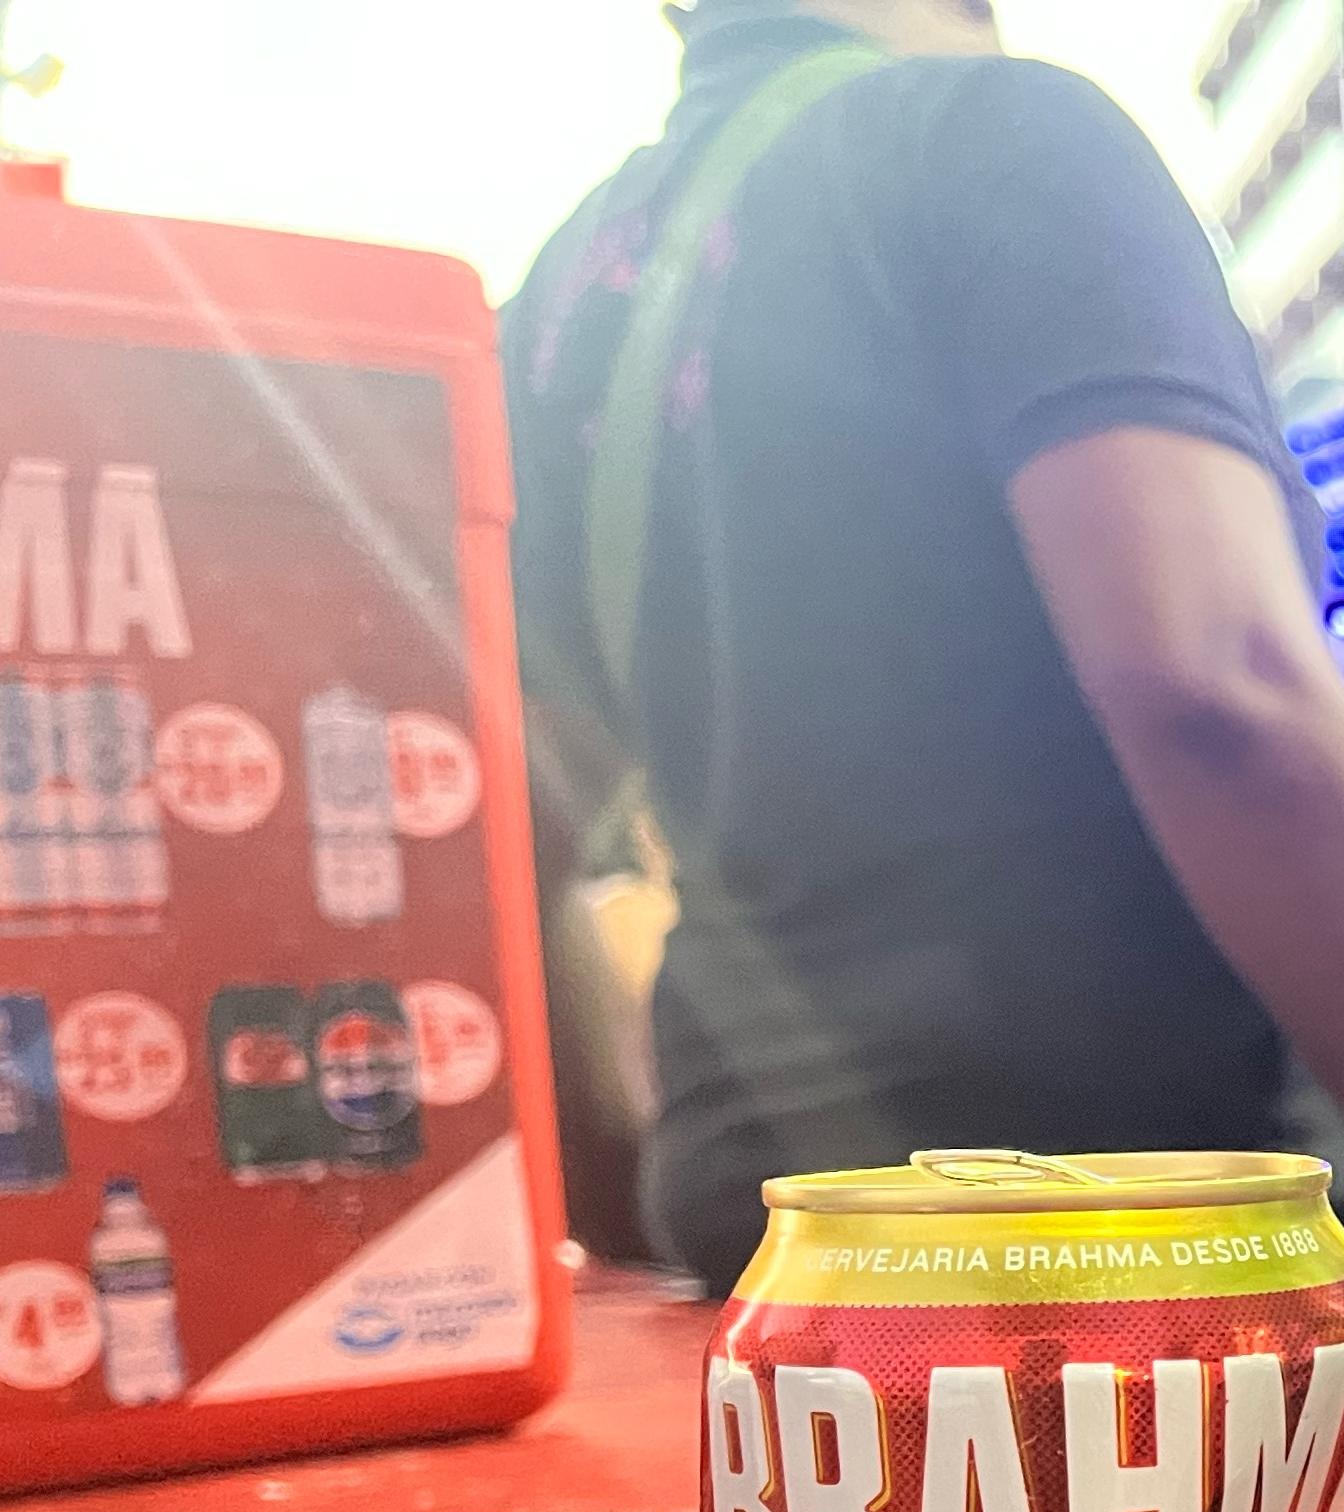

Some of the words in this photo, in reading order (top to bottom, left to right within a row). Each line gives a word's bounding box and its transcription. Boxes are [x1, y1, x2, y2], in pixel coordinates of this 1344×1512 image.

[807, 1244, 989, 1274] CERVEJARIA
[1004, 1242, 1160, 1272] BRAHMA
[1172, 1234, 1270, 1267] DESDE
[1273, 1227, 1319, 1258] 1888
